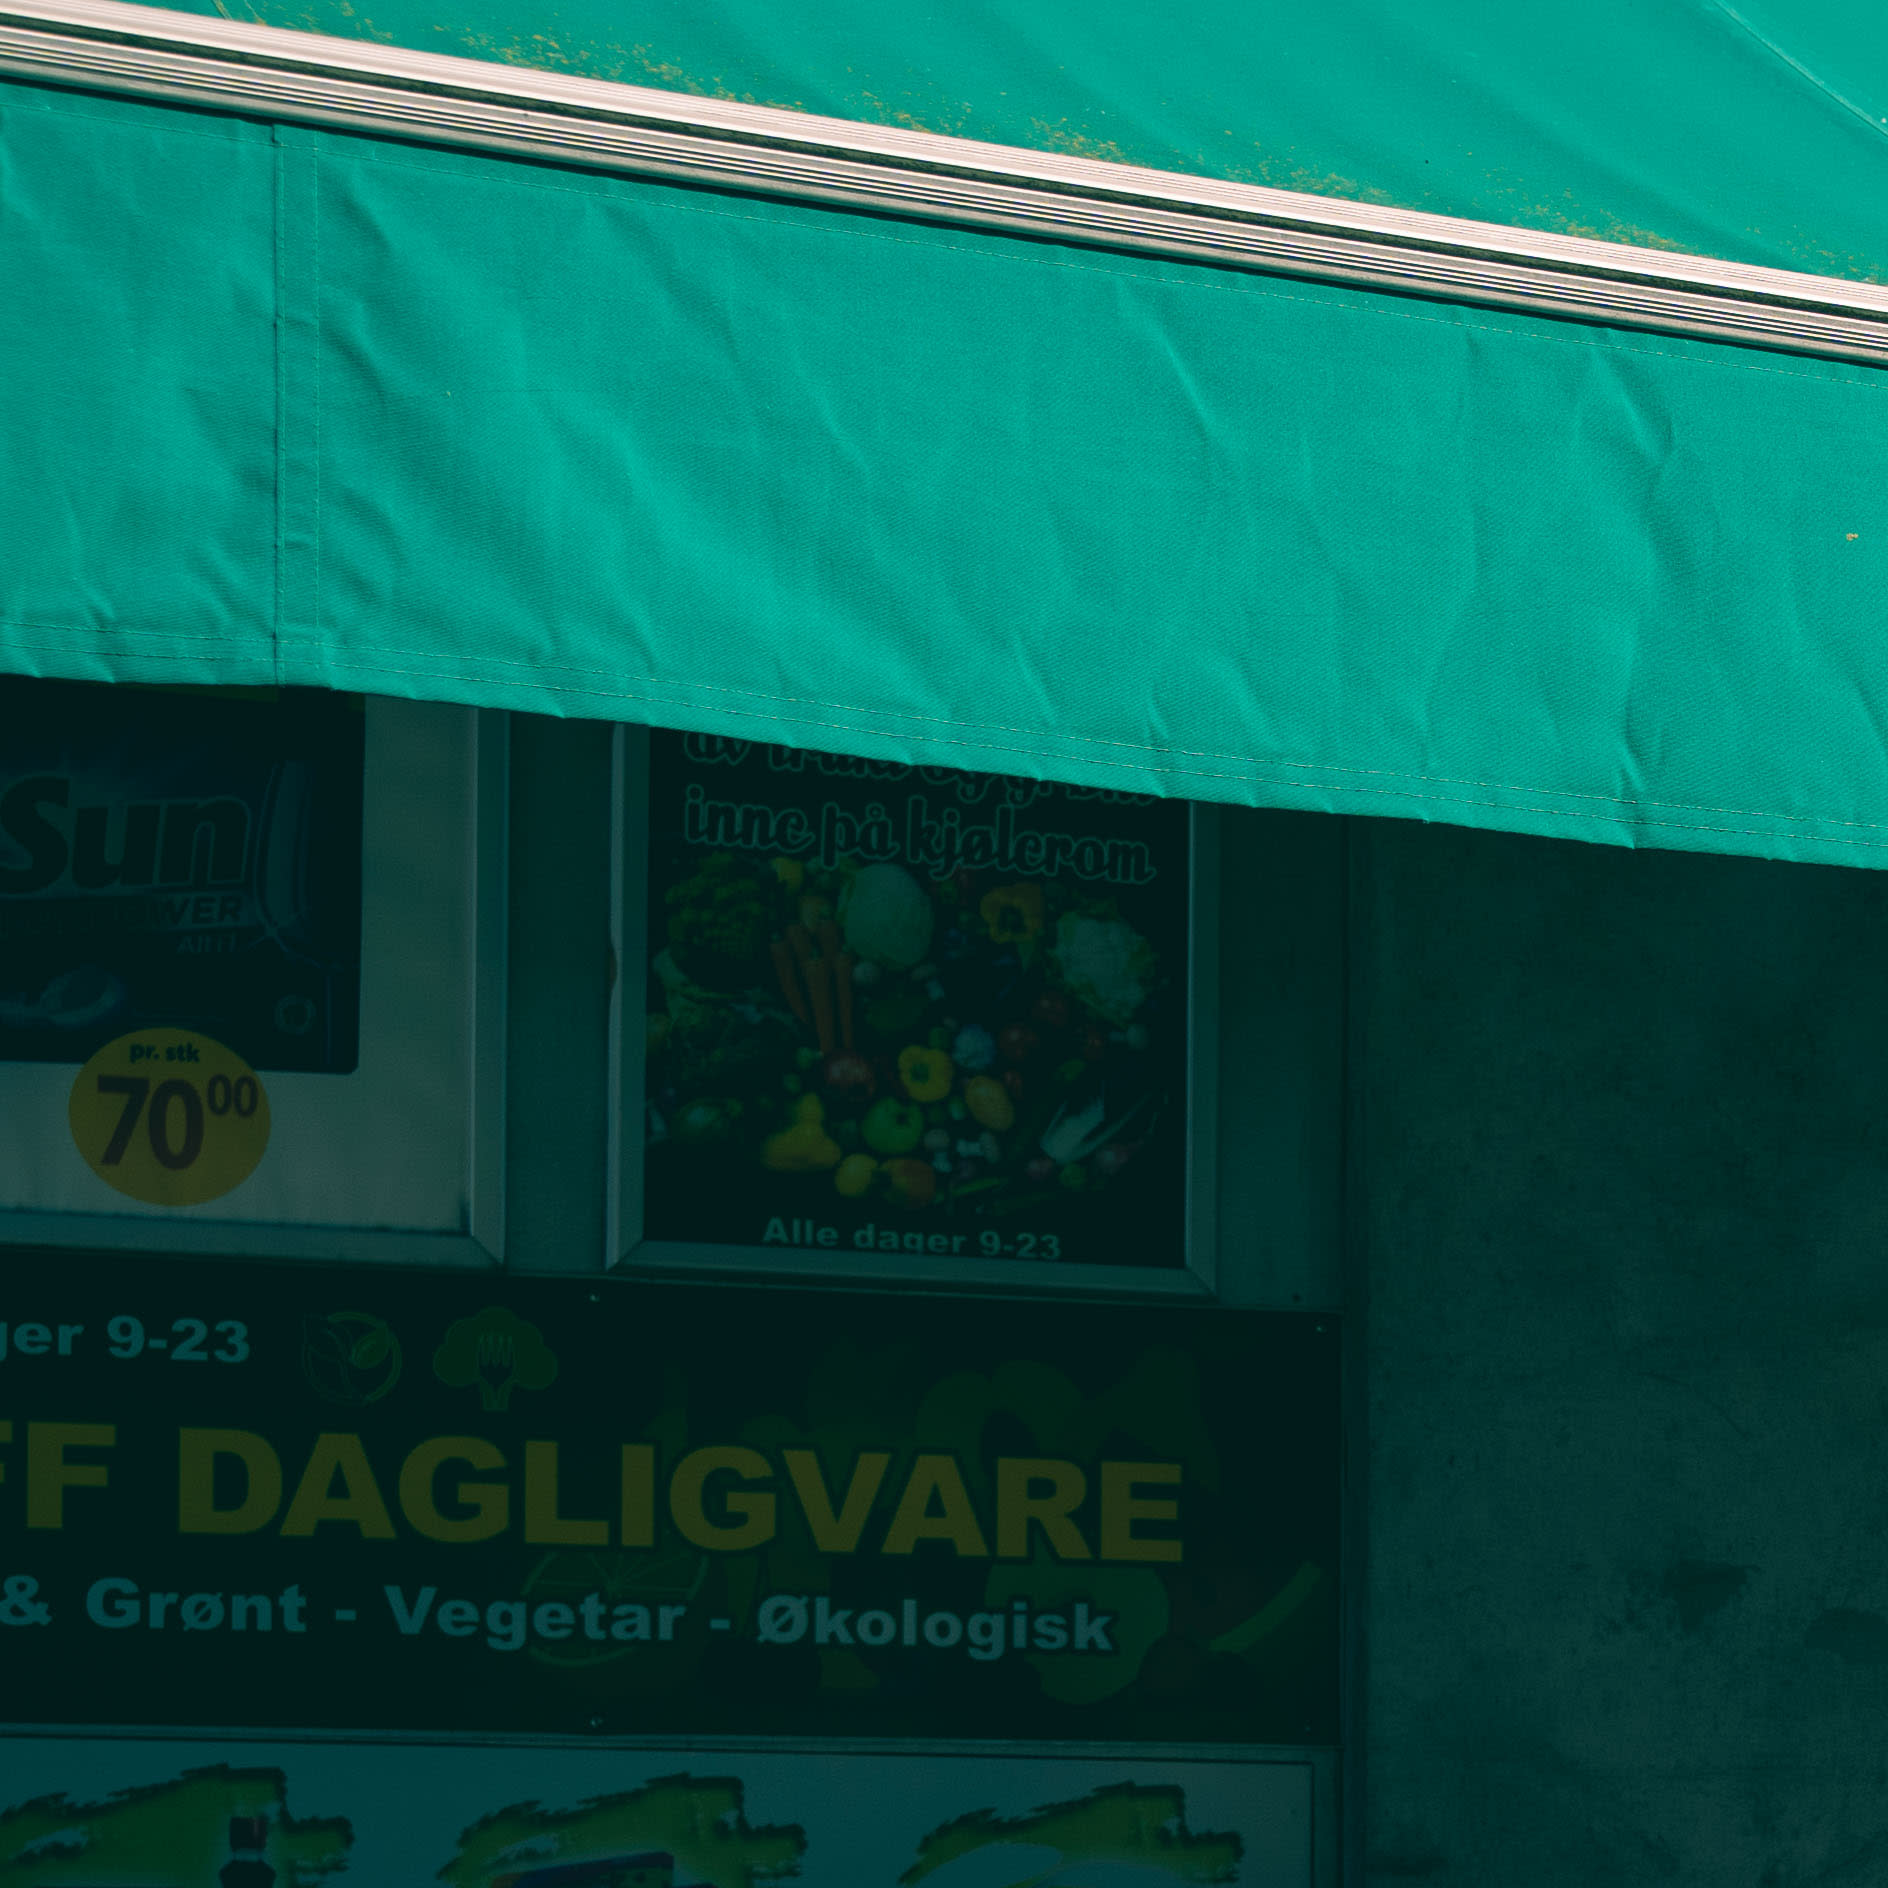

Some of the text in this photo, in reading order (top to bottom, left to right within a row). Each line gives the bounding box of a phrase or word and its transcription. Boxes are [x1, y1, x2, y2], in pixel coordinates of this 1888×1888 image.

[684, 785, 814, 849] inne
[821, 804, 899, 871] på
[166, 1044, 200, 1062] stk
[96, 1073, 205, 1171] 70
[762, 1217, 840, 1247] Alle
[979, 1231, 1062, 1260] 9-23
[106, 1315, 252, 1363] 9-23
[178, 1426, 1182, 1562] DAGLIGVARE
[2, 1574, 1119, 1661] & Grønt Vegetar Økologisk
